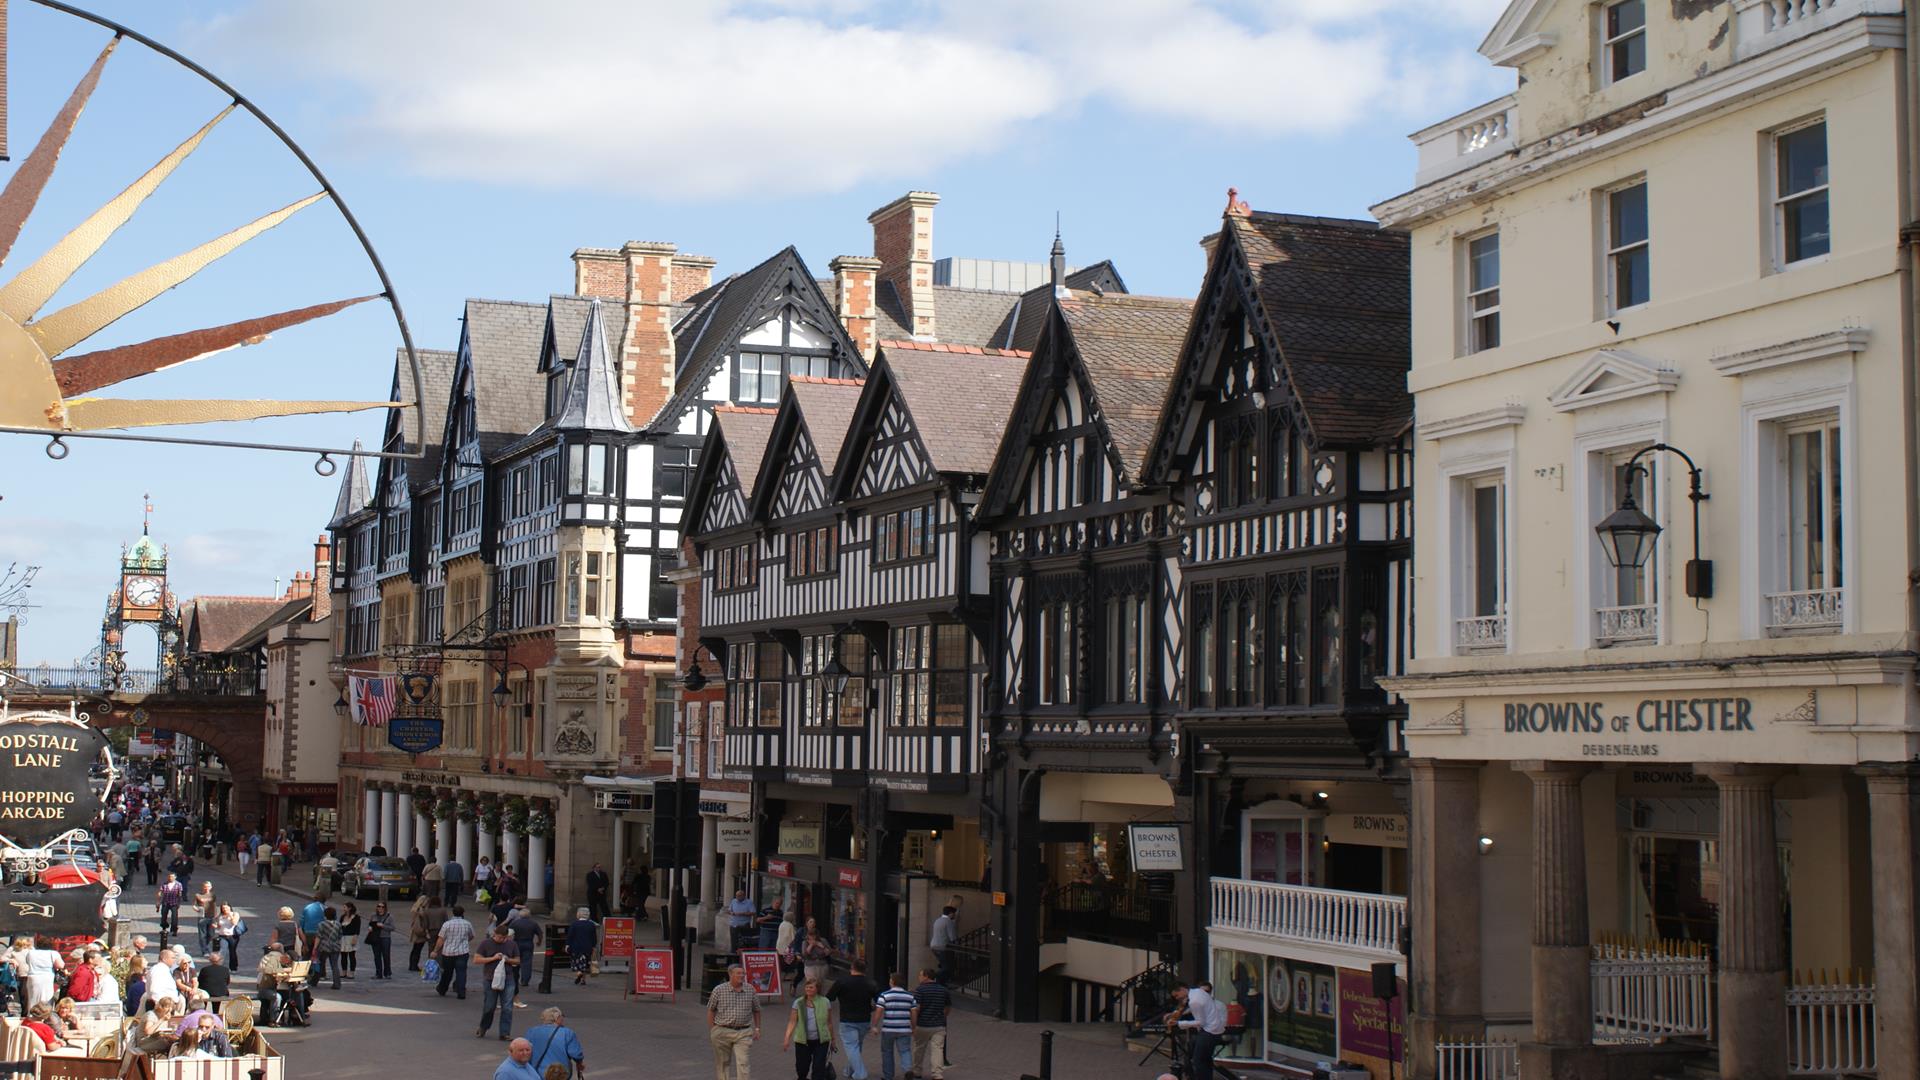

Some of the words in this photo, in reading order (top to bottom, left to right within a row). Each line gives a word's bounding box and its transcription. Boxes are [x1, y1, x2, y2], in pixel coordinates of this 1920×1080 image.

[1504, 702, 1604, 733] BROWNS
[1611, 715, 1631, 732] OF
[1636, 698, 1754, 732] CHESTER
[1582, 744, 1660, 756] DEBENHAMS
[14, 753, 62, 768] LANE
[1633, 770, 1693, 784] BROWNS
[2, 791, 75, 803] HOPPING
[1, 807, 65, 819] ARCADE
[1353, 816, 1395, 831] BROWNS
[1137, 833, 1176, 842] BROWNS
[1139, 850, 1178, 858] CHESTER
